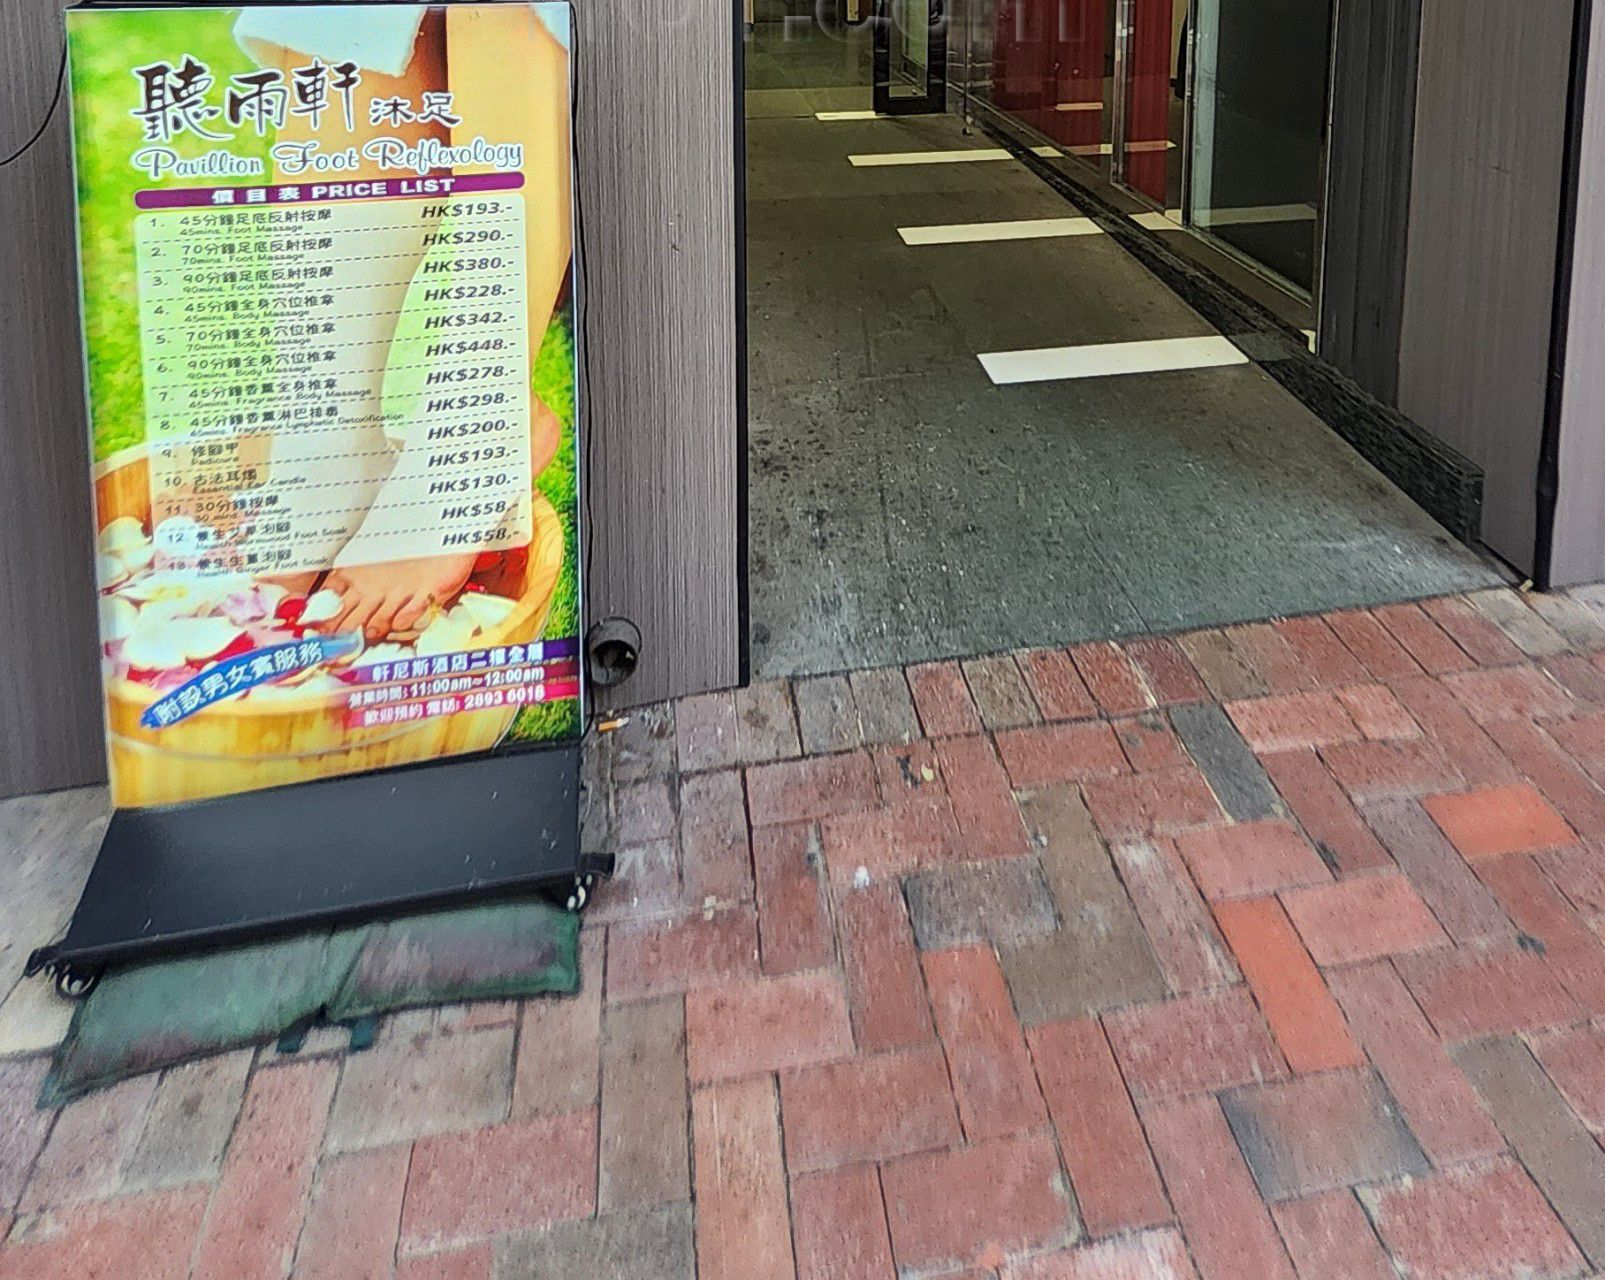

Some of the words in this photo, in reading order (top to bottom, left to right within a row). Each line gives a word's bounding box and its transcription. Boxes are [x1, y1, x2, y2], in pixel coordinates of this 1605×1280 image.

[131, 56, 360, 140] 聽雨軒
[370, 93, 462, 126] 沐足
[134, 148, 262, 178] Pavillion
[272, 141, 359, 173] Foot
[363, 137, 523, 173] Reflexology
[311, 181, 388, 199] PRICE
[400, 178, 456, 195] LIST
